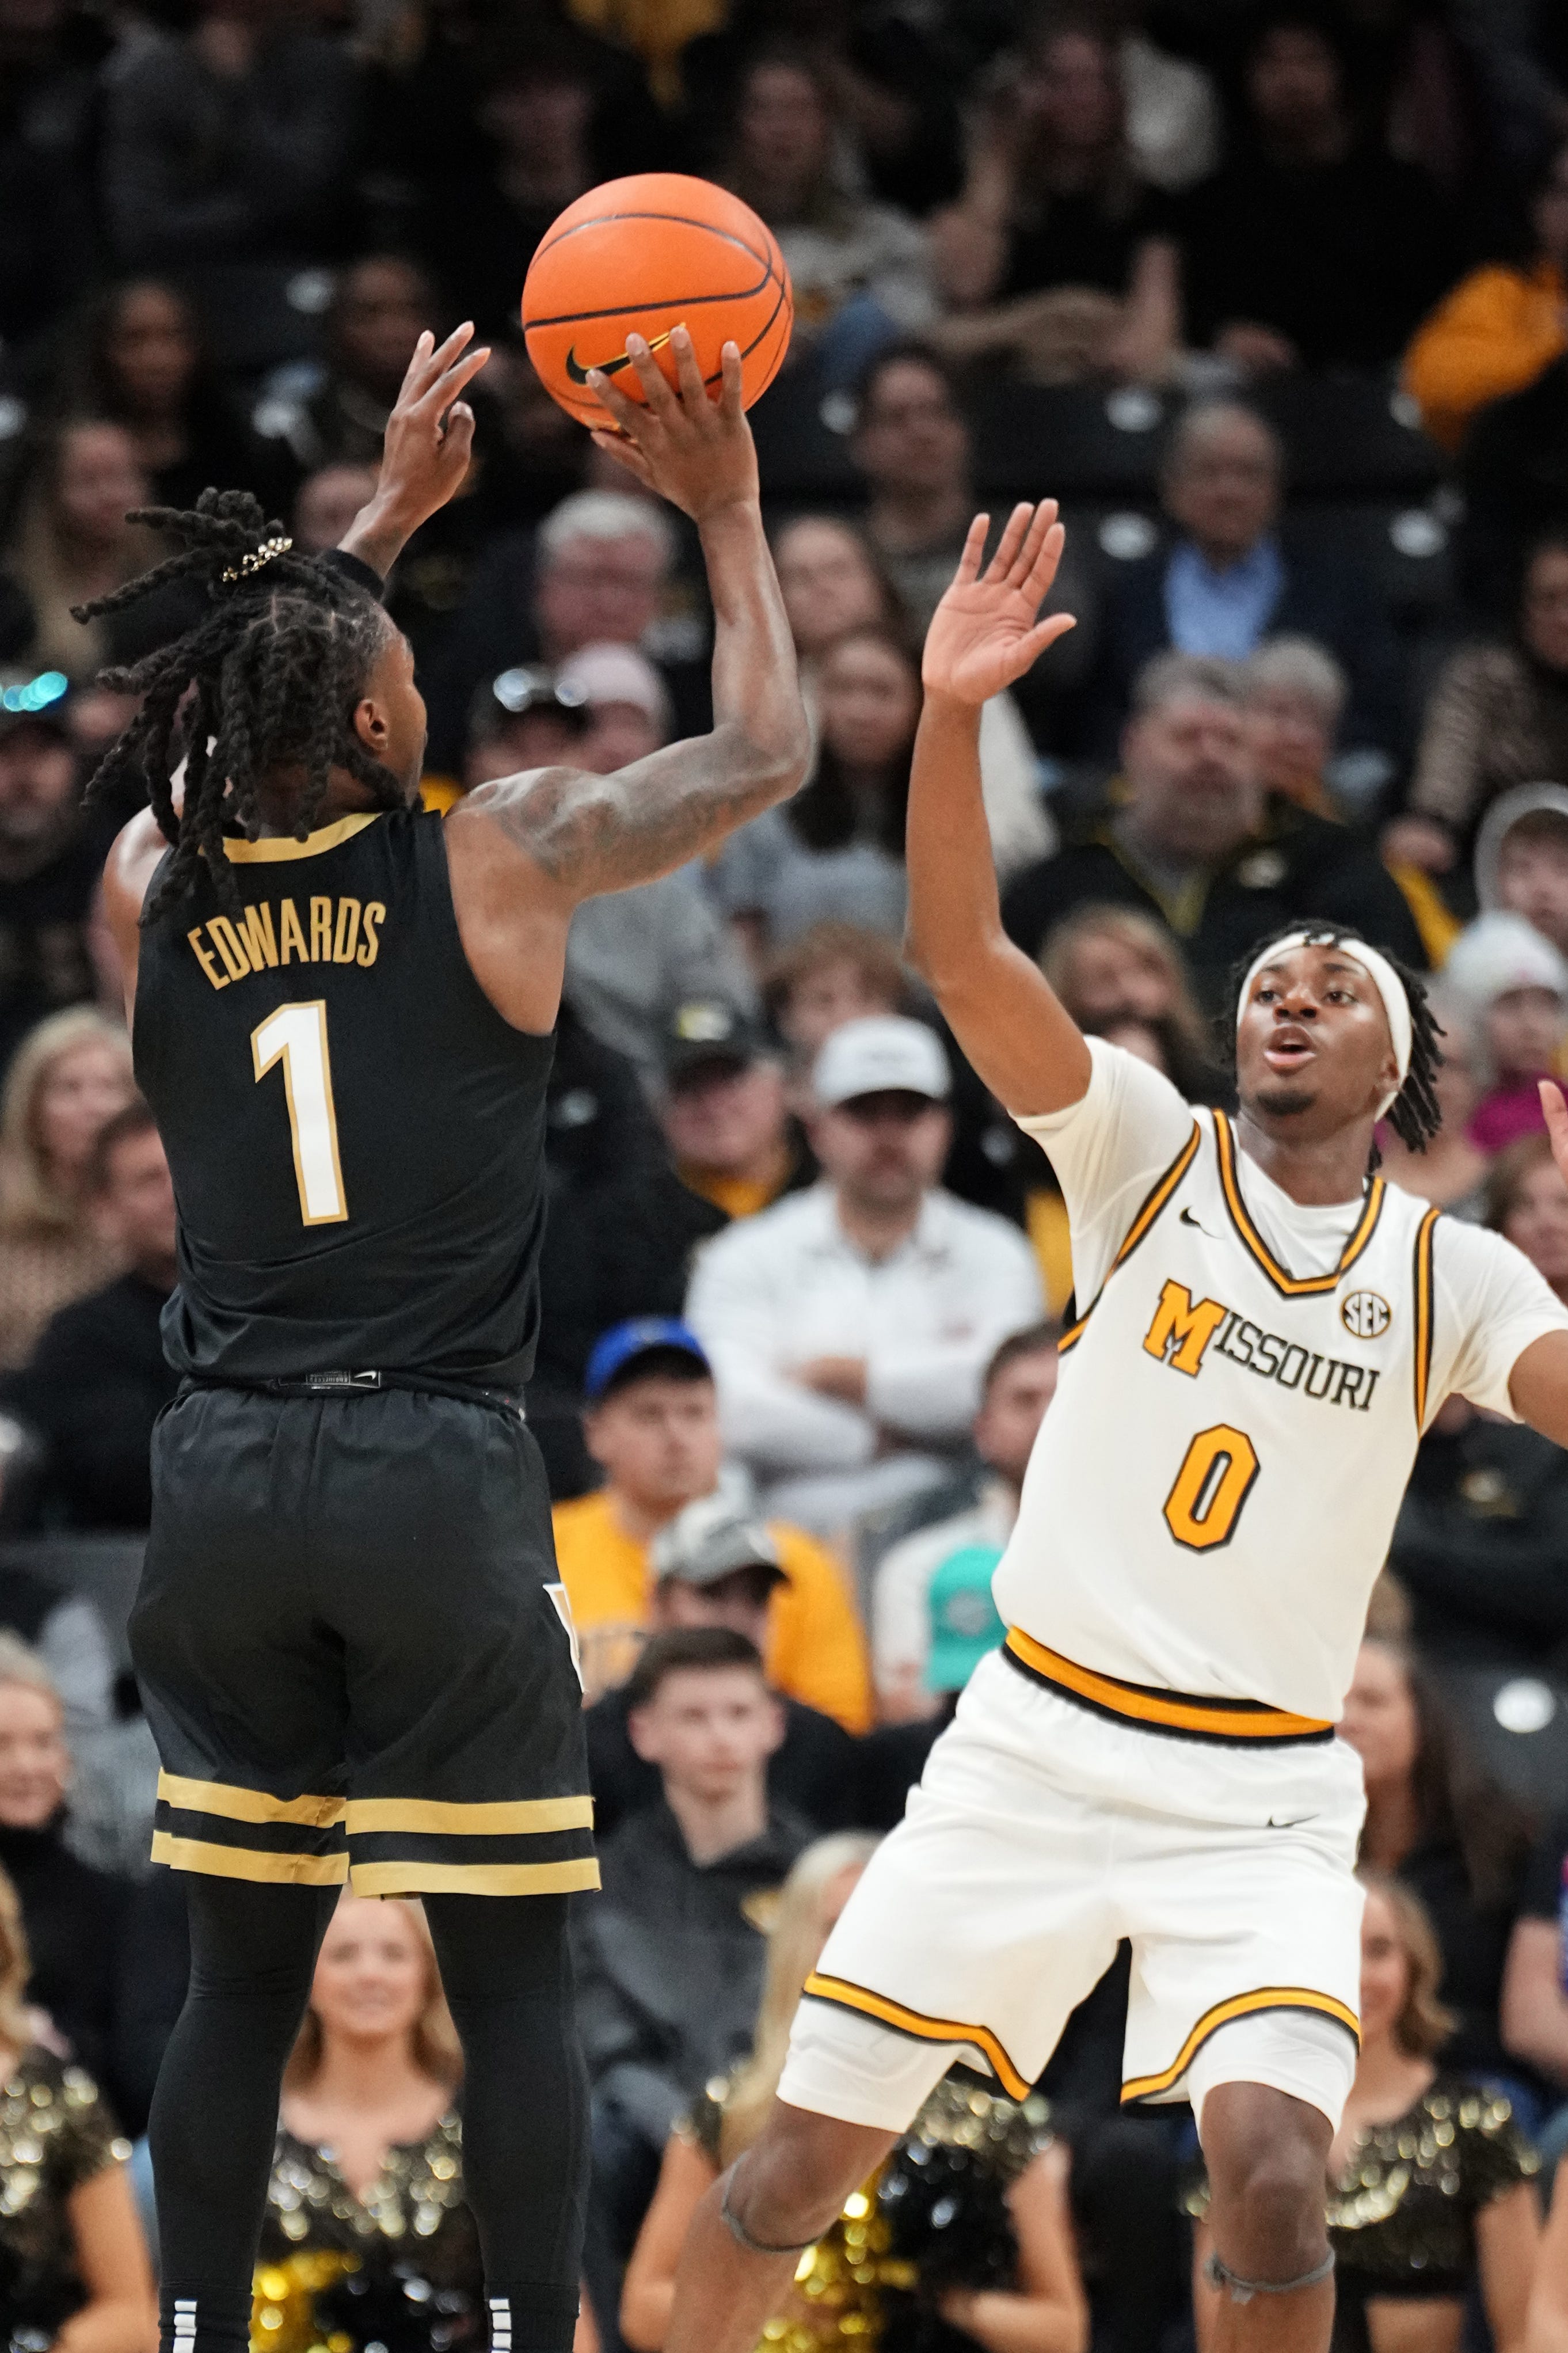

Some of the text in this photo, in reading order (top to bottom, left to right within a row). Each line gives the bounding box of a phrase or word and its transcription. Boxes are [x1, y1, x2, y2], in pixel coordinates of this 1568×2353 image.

[187, 896, 386, 990] EDWARDS
[250, 999, 349, 1226] 1
[1344, 1293, 1388, 1336] SEC
[1162, 1423, 1261, 1556] 0
